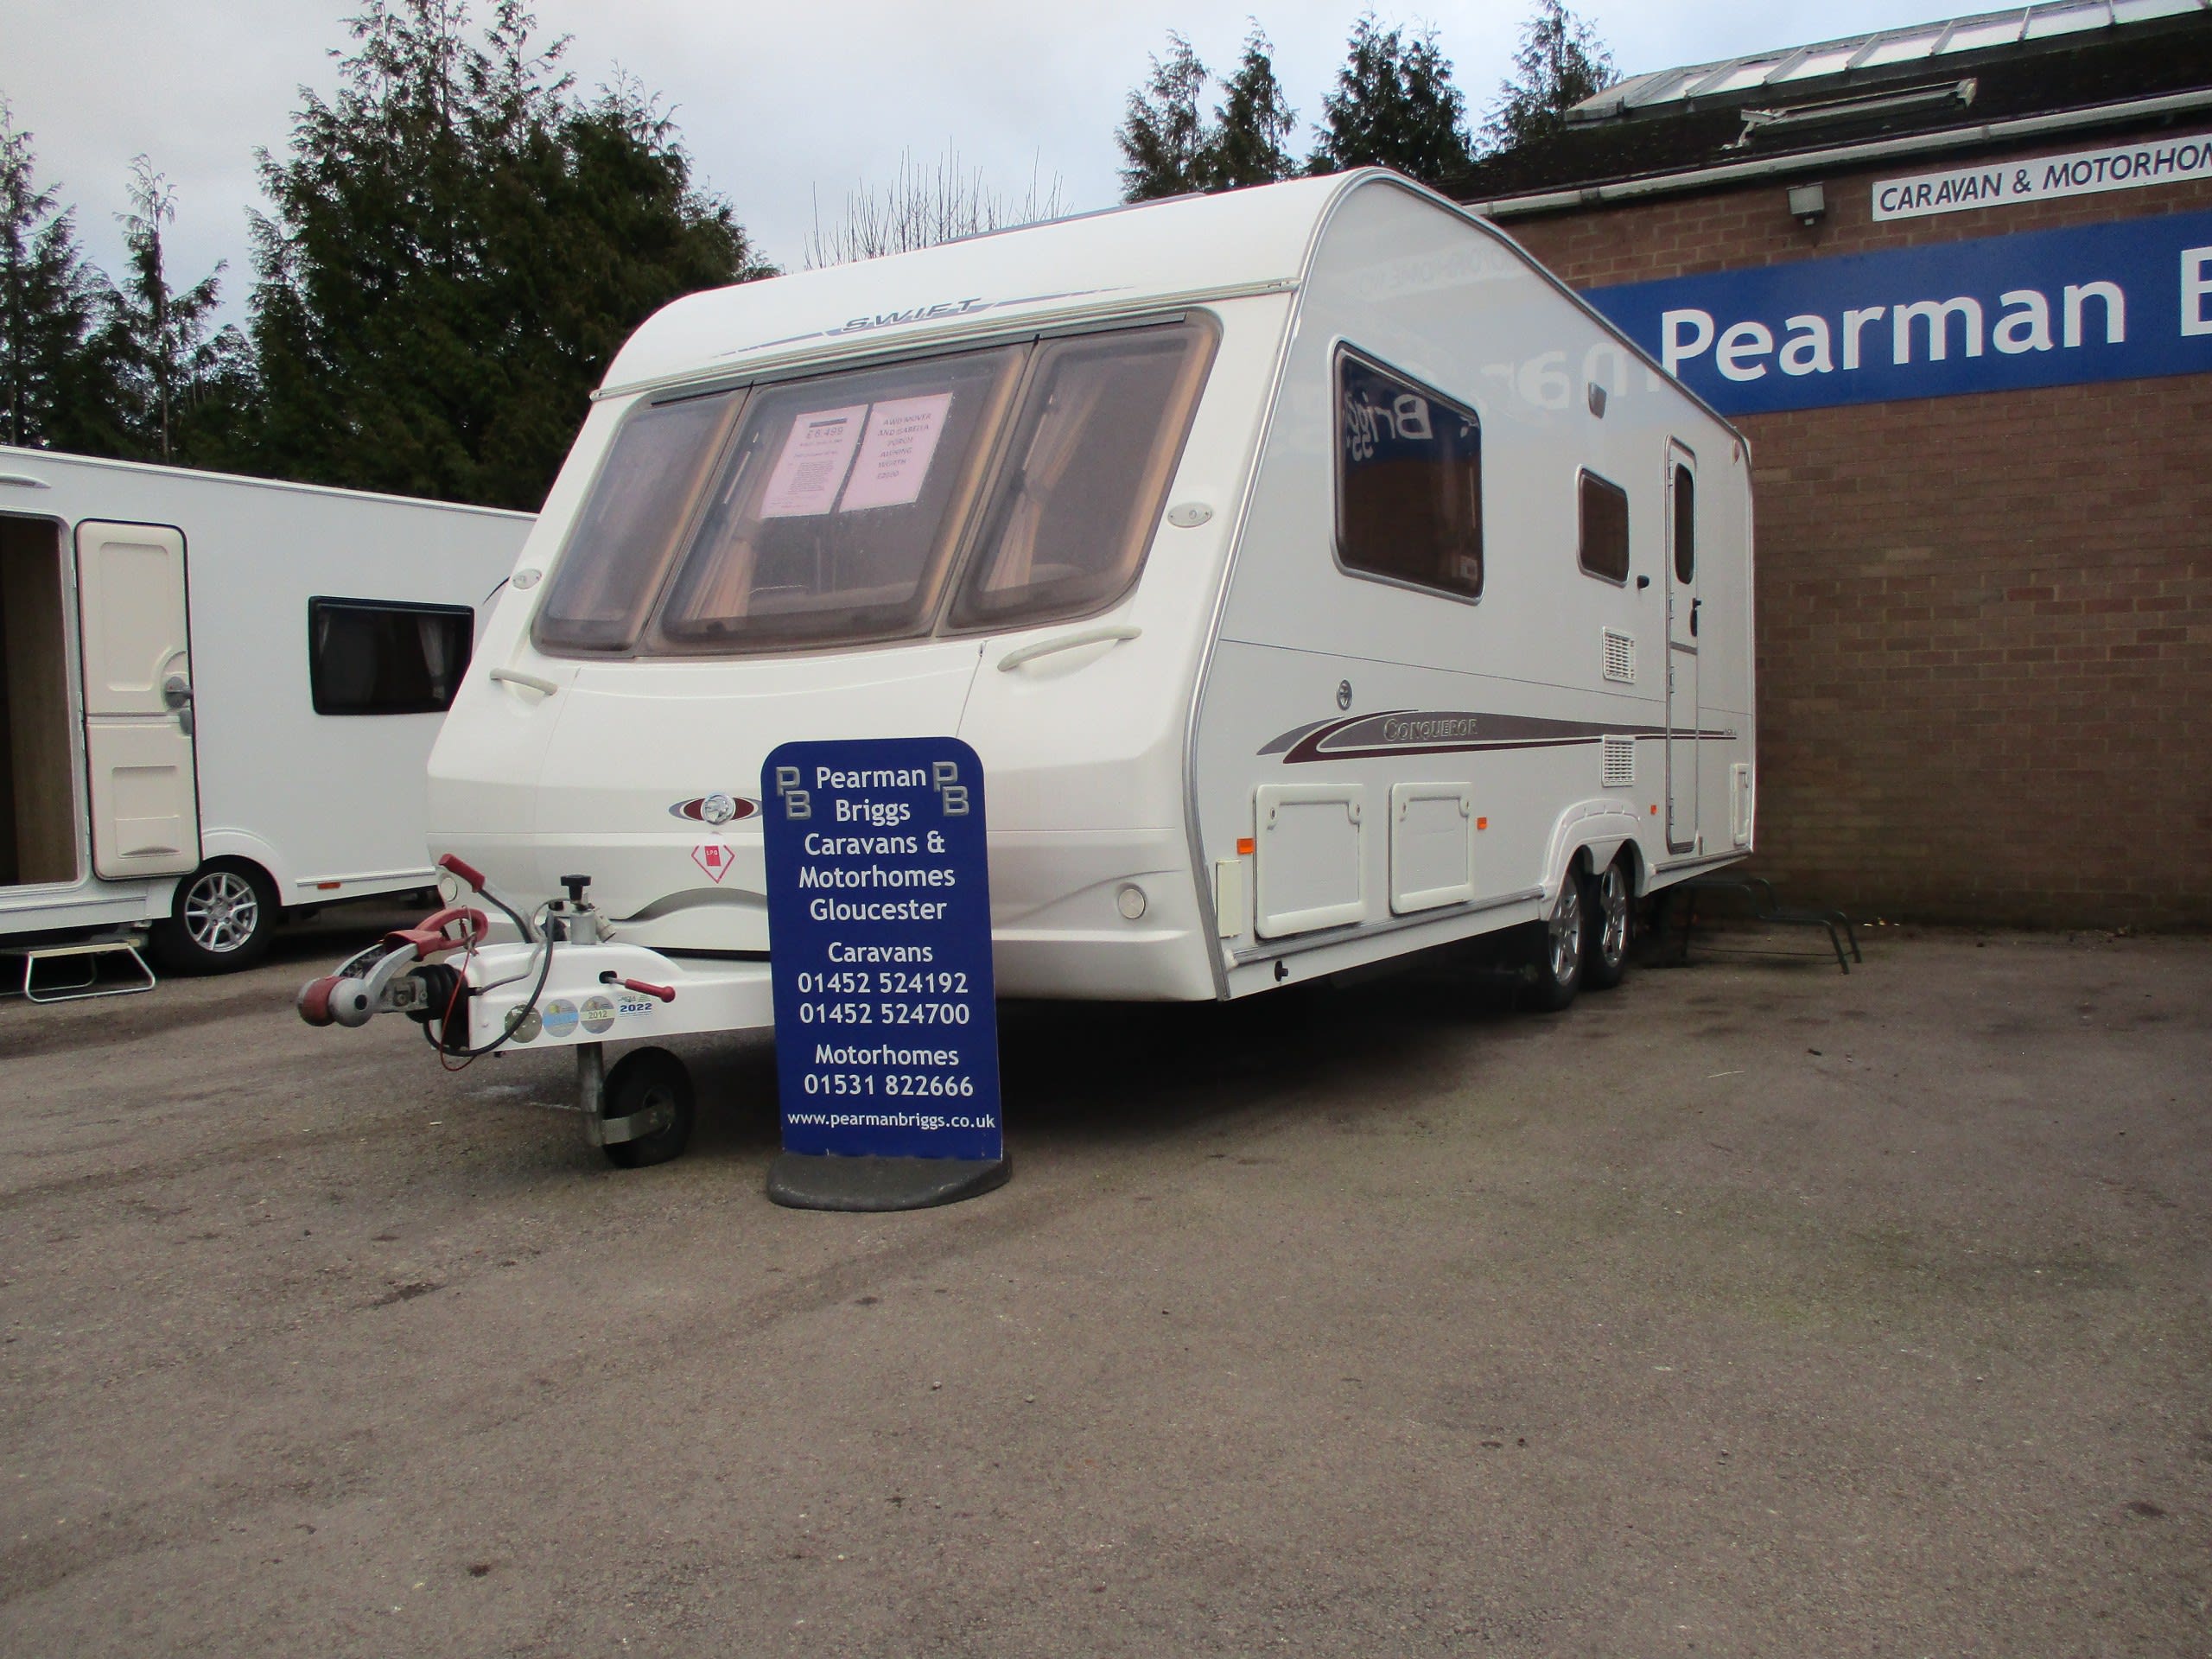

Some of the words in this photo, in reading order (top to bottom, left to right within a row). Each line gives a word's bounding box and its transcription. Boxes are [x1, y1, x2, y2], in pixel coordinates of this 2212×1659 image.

[1879, 172, 2003, 213] CARAVAN
[2012, 168, 2032, 194] &
[842, 297, 982, 332] SWIFT
[1661, 281, 2126, 383] Pearman
[817, 766, 927, 789] Pearman
[836, 798, 911, 827] Briggs
[804, 833, 918, 855] Caravans
[927, 830, 945, 853] &
[799, 864, 956, 888] Motorhomes
[810, 898, 947, 921] Gloucester
[828, 942, 933, 963] Caravans
[798, 972, 871, 993] 01452
[880, 972, 969, 993] 524192
[588, 1010, 607, 1019] 2012
[620, 1002, 652, 1013] 2022
[799, 1002, 873, 1024] 01452
[881, 1003, 969, 1025] 524700
[815, 1044, 960, 1065] Motorhomes
[804, 1074, 874, 1095] 01531
[885, 1075, 974, 1096] 822666
[787, 1113, 996, 1130] www.pearmanbriggs.co.uk
